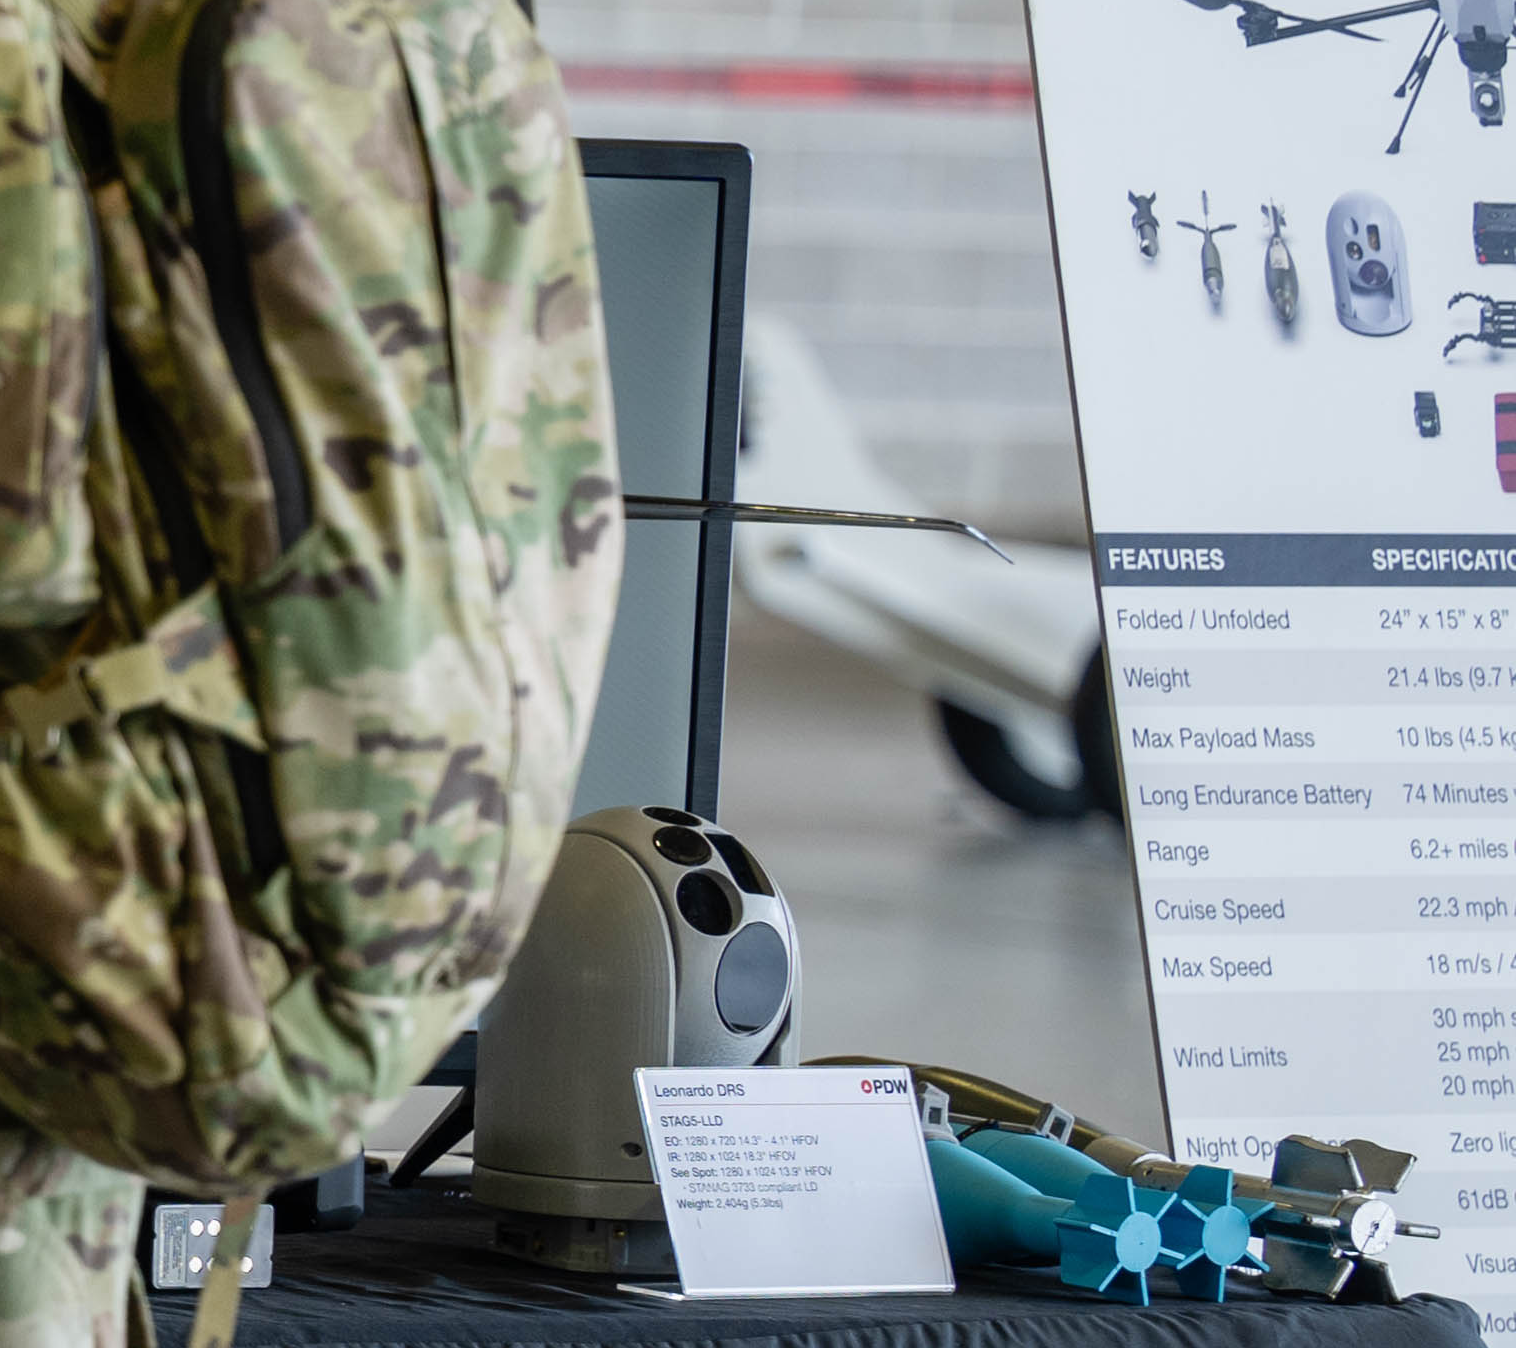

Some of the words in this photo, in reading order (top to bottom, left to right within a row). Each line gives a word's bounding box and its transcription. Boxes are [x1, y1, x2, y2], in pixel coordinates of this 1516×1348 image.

[1108, 548, 1225, 571] FEATURES
[1116, 609, 1183, 630] Folded
[1189, 609, 1196, 631] /
[1202, 609, 1291, 630] Unfolded
[1418, 614, 1430, 630] x
[1473, 614, 1485, 630] x
[1123, 667, 1191, 694] Weight
[1387, 666, 1429, 687] 21.4
[1434, 666, 1463, 687] lbs
[1469, 666, 1502, 692] (9.7
[1131, 728, 1174, 748] Max
[1179, 728, 1256, 754] Payload
[1263, 727, 1315, 748] Mass
[1396, 726, 1419, 747] 10
[1424, 726, 1453, 747] lbs
[1459, 726, 1494, 752] (4.5
[1139, 785, 1189, 811] Long
[1194, 784, 1298, 805] Endurance
[1303, 783, 1373, 809] Battery
[1402, 783, 1427, 803] 74
[1432, 783, 1509, 803] Minutes
[1146, 840, 1210, 866] Range
[1410, 838, 1452, 859] 6.2+
[1459, 837, 1509, 859] miles
[1154, 898, 1217, 920] Cruise
[1222, 898, 1286, 925] Speed
[1418, 896, 1460, 917] 22.3
[1465, 896, 1508, 922] mph
[1162, 957, 1204, 977] Max
[1209, 956, 1274, 981] Speed
[1427, 953, 1450, 974] 18
[1456, 953, 1492, 974] m/s
[1497, 953, 1504, 974] /
[1432, 1007, 1457, 1029] 30
[1463, 1007, 1505, 1033] mph
[1173, 1046, 1224, 1068] Wind
[1229, 1046, 1289, 1067] Limits
[1437, 1041, 1461, 1062] 25
[1467, 1041, 1510, 1066] mph
[654, 1084, 714, 1098] Leonardo
[716, 1083, 746, 1097] DRS
[873, 1079, 908, 1094] PDW
[1441, 1075, 1466, 1096] 20
[1471, 1074, 1515, 1100] mph
[659, 1115, 724, 1128] STAG5-LLD
[718, 1136, 736, 1146] 720
[1186, 1136, 1240, 1163] Night
[1449, 1132, 1494, 1154] Zero
[670, 1167, 690, 1178] See
[757, 1182, 803, 1194] compliant
[804, 1181, 818, 1192] LD
[1457, 1189, 1509, 1211] 61dB
[676, 1199, 715, 1211] Weight:
